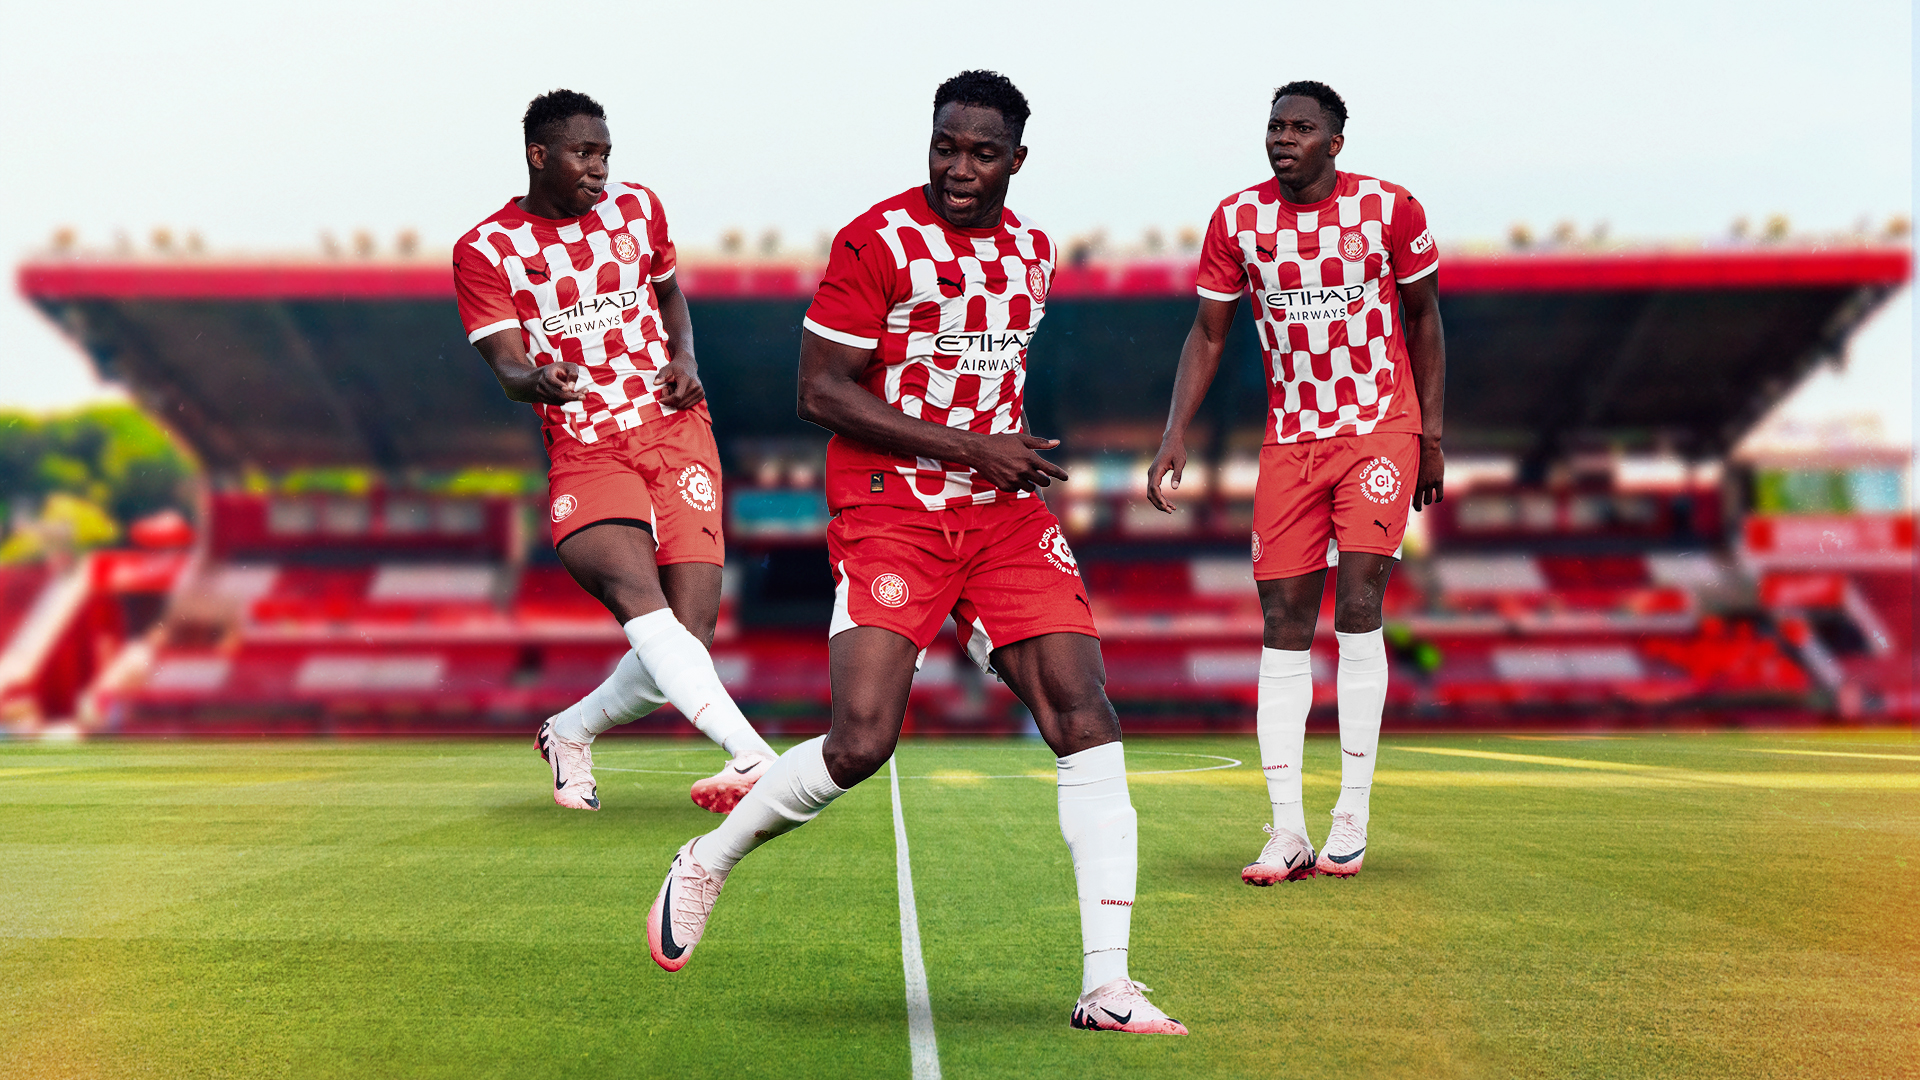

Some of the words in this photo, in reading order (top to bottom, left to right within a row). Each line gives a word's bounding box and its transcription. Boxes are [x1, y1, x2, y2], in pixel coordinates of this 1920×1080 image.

[1266, 285, 1365, 306] ETIHAD
[542, 290, 637, 332] ETIHAD
[1288, 307, 1347, 321] AIRWAYS
[676, 465, 697, 487] Costa
[1359, 458, 1380, 480] Costa
[1380, 456, 1400, 477] Brava
[1375, 474, 1390, 488] G!
[1360, 482, 1379, 504] Pirineu
[1038, 526, 1056, 550] Costa
[1043, 552, 1072, 575] Pirineu
[880, 575, 904, 587] GIRONA
